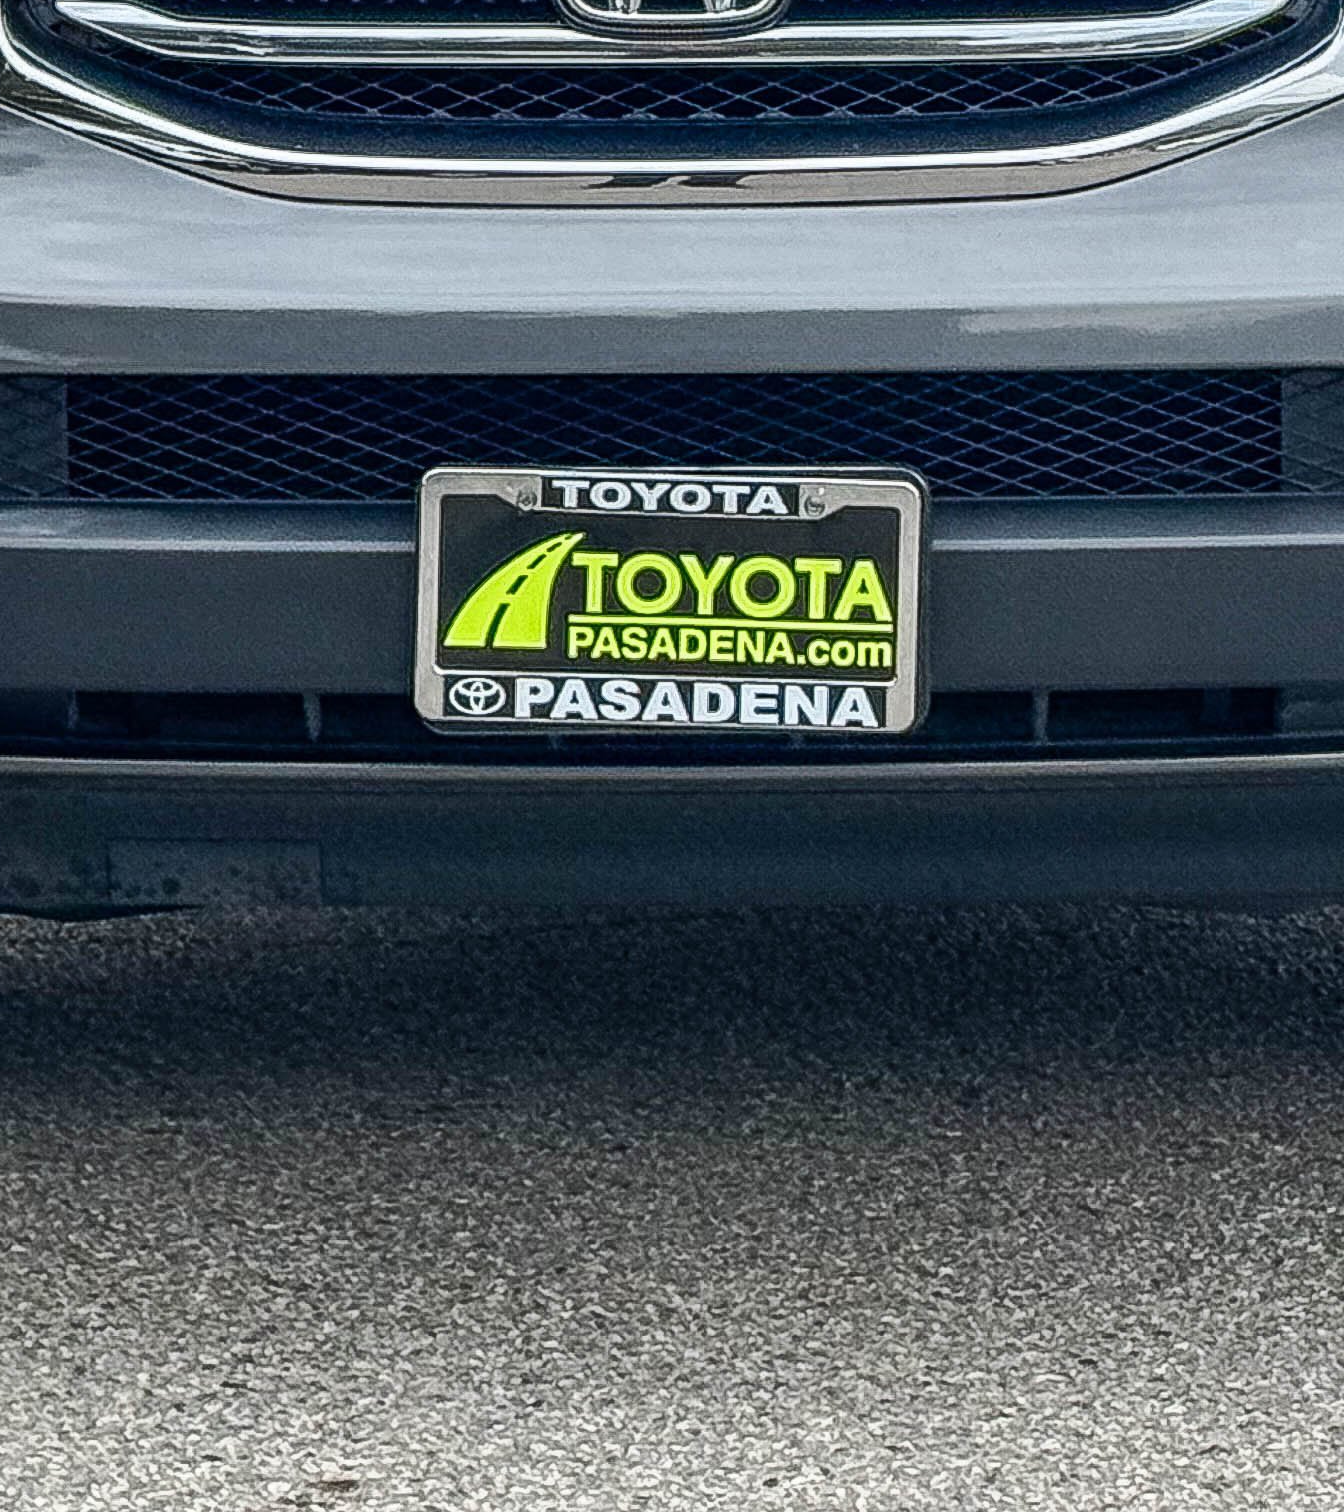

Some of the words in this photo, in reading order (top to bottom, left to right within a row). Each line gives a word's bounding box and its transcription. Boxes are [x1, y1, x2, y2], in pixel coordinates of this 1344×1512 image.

[552, 480, 789, 516] TOYOTA
[571, 551, 893, 623] TOYOTA
[567, 626, 893, 668] PASADENA.com
[514, 679, 880, 728] PASADENA
